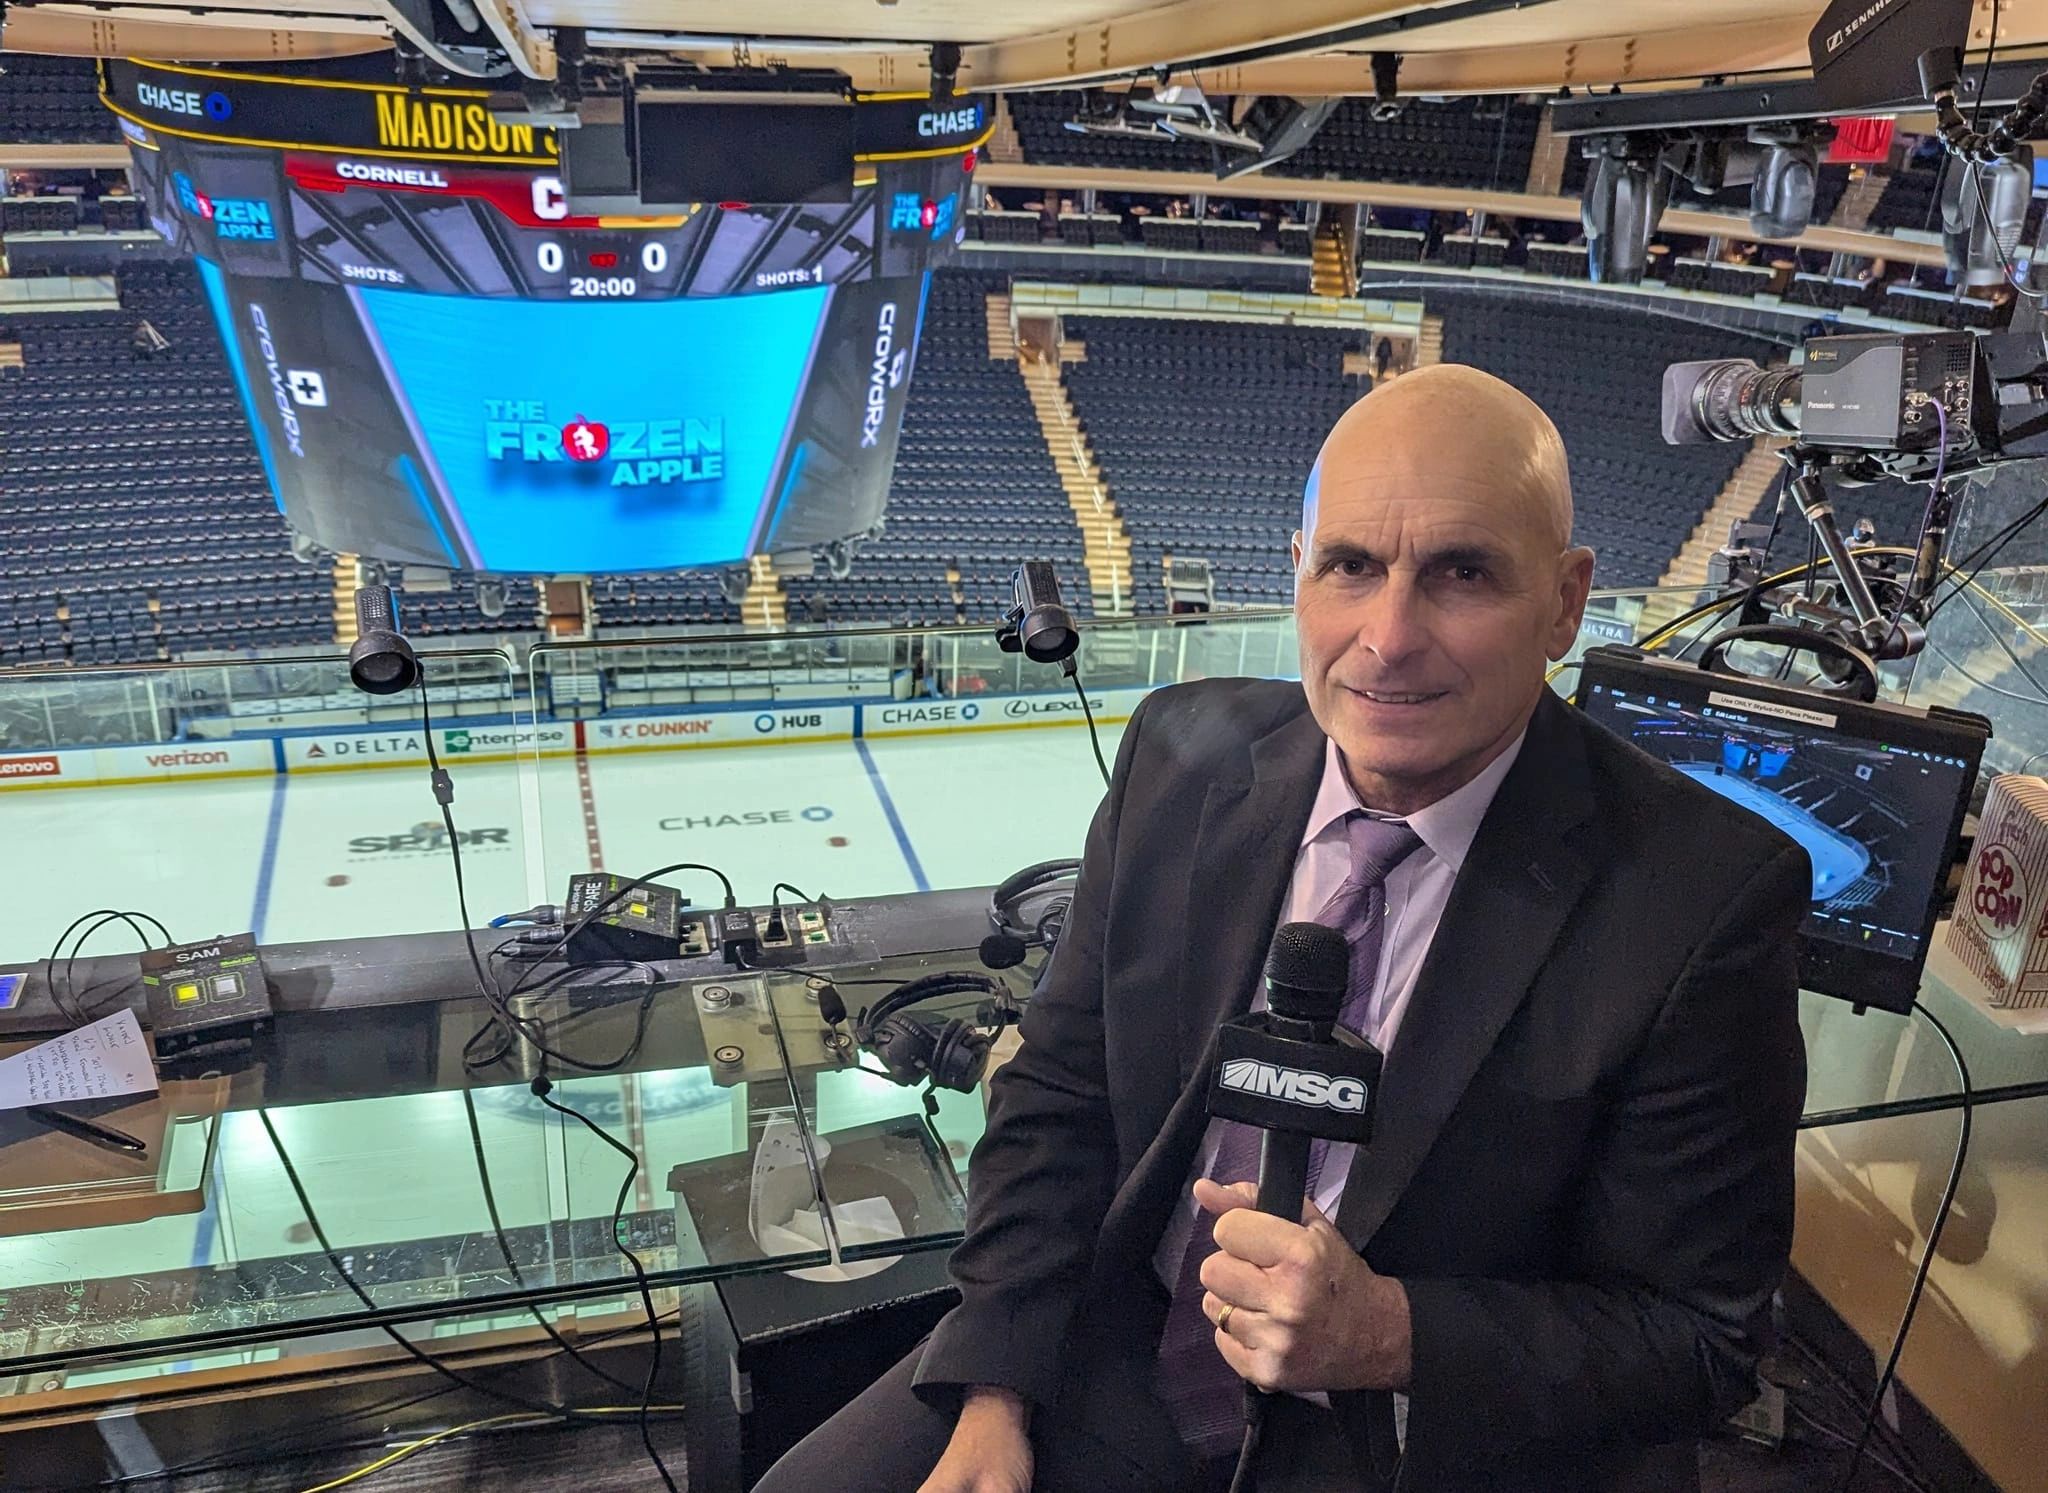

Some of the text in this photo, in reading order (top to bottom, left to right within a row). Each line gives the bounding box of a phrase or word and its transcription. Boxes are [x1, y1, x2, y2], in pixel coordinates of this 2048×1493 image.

[137, 83, 203, 116] CHASE
[376, 93, 534, 153] MADISON
[917, 107, 976, 136] CHASE
[336, 162, 449, 188] CORNELL
[217, 224, 275, 239] APPLE
[537, 241, 564, 273] 0
[641, 241, 668, 273] 0
[341, 263, 405, 283] SHOTS:
[756, 264, 824, 287] SHOTS: 1
[569, 277, 637, 297] 20:00
[484, 399, 545, 420] THE
[609, 455, 723, 487] APPLE
[1582, 623, 1624, 640] ULTRA
[882, 705, 957, 724] CHASE
[1720, 696, 1733, 705] Use
[1734, 699, 1752, 709] ONLY
[1802, 712, 1824, 722] Please
[781, 714, 822, 729] HUB
[146, 749, 229, 767] verizon
[334, 737, 420, 755] DELTA
[0, 761, 54, 775] enovo
[658, 810, 795, 831] CHASE
[1979, 849, 2015, 895] POP
[583, 881, 602, 912] SPARE
[1974, 884, 2023, 930] CORN
[175, 947, 221, 963] SAM
[1984, 964, 2006, 989] CRISP
[1256, 1065, 1365, 1111] MSG
